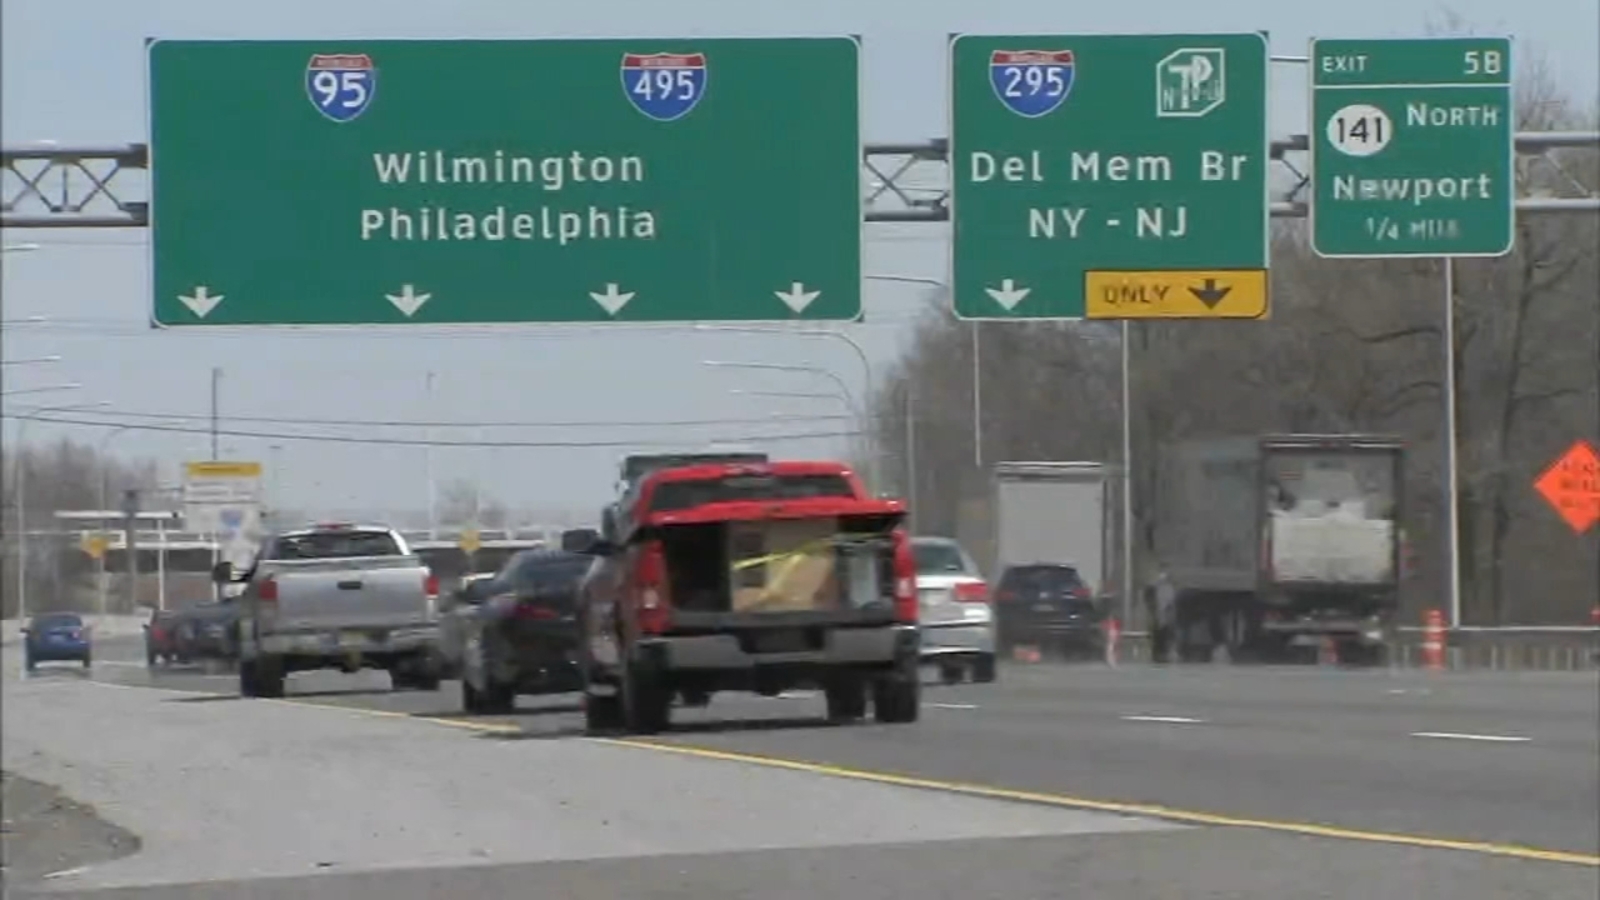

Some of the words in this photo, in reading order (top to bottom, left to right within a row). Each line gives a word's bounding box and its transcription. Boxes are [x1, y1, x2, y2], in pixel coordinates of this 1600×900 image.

[1322, 55, 1368, 73] EXIT
[1463, 51, 1501, 75] 5B
[313, 71, 366, 108] 95
[633, 70, 695, 101] 495
[1004, 66, 1064, 97] 295
[1337, 117, 1383, 144] 141
[374, 151, 643, 190] Wilmington
[970, 150, 1044, 182] Del
[1071, 152, 1172, 182] Mem
[1201, 151, 1248, 182] Br
[1333, 174, 1491, 206] Newport
[361, 207, 657, 246] Philadelphia
[1029, 208, 1087, 238] NY
[1136, 207, 1188, 238] NJ
[1104, 284, 1170, 304] ONLY
